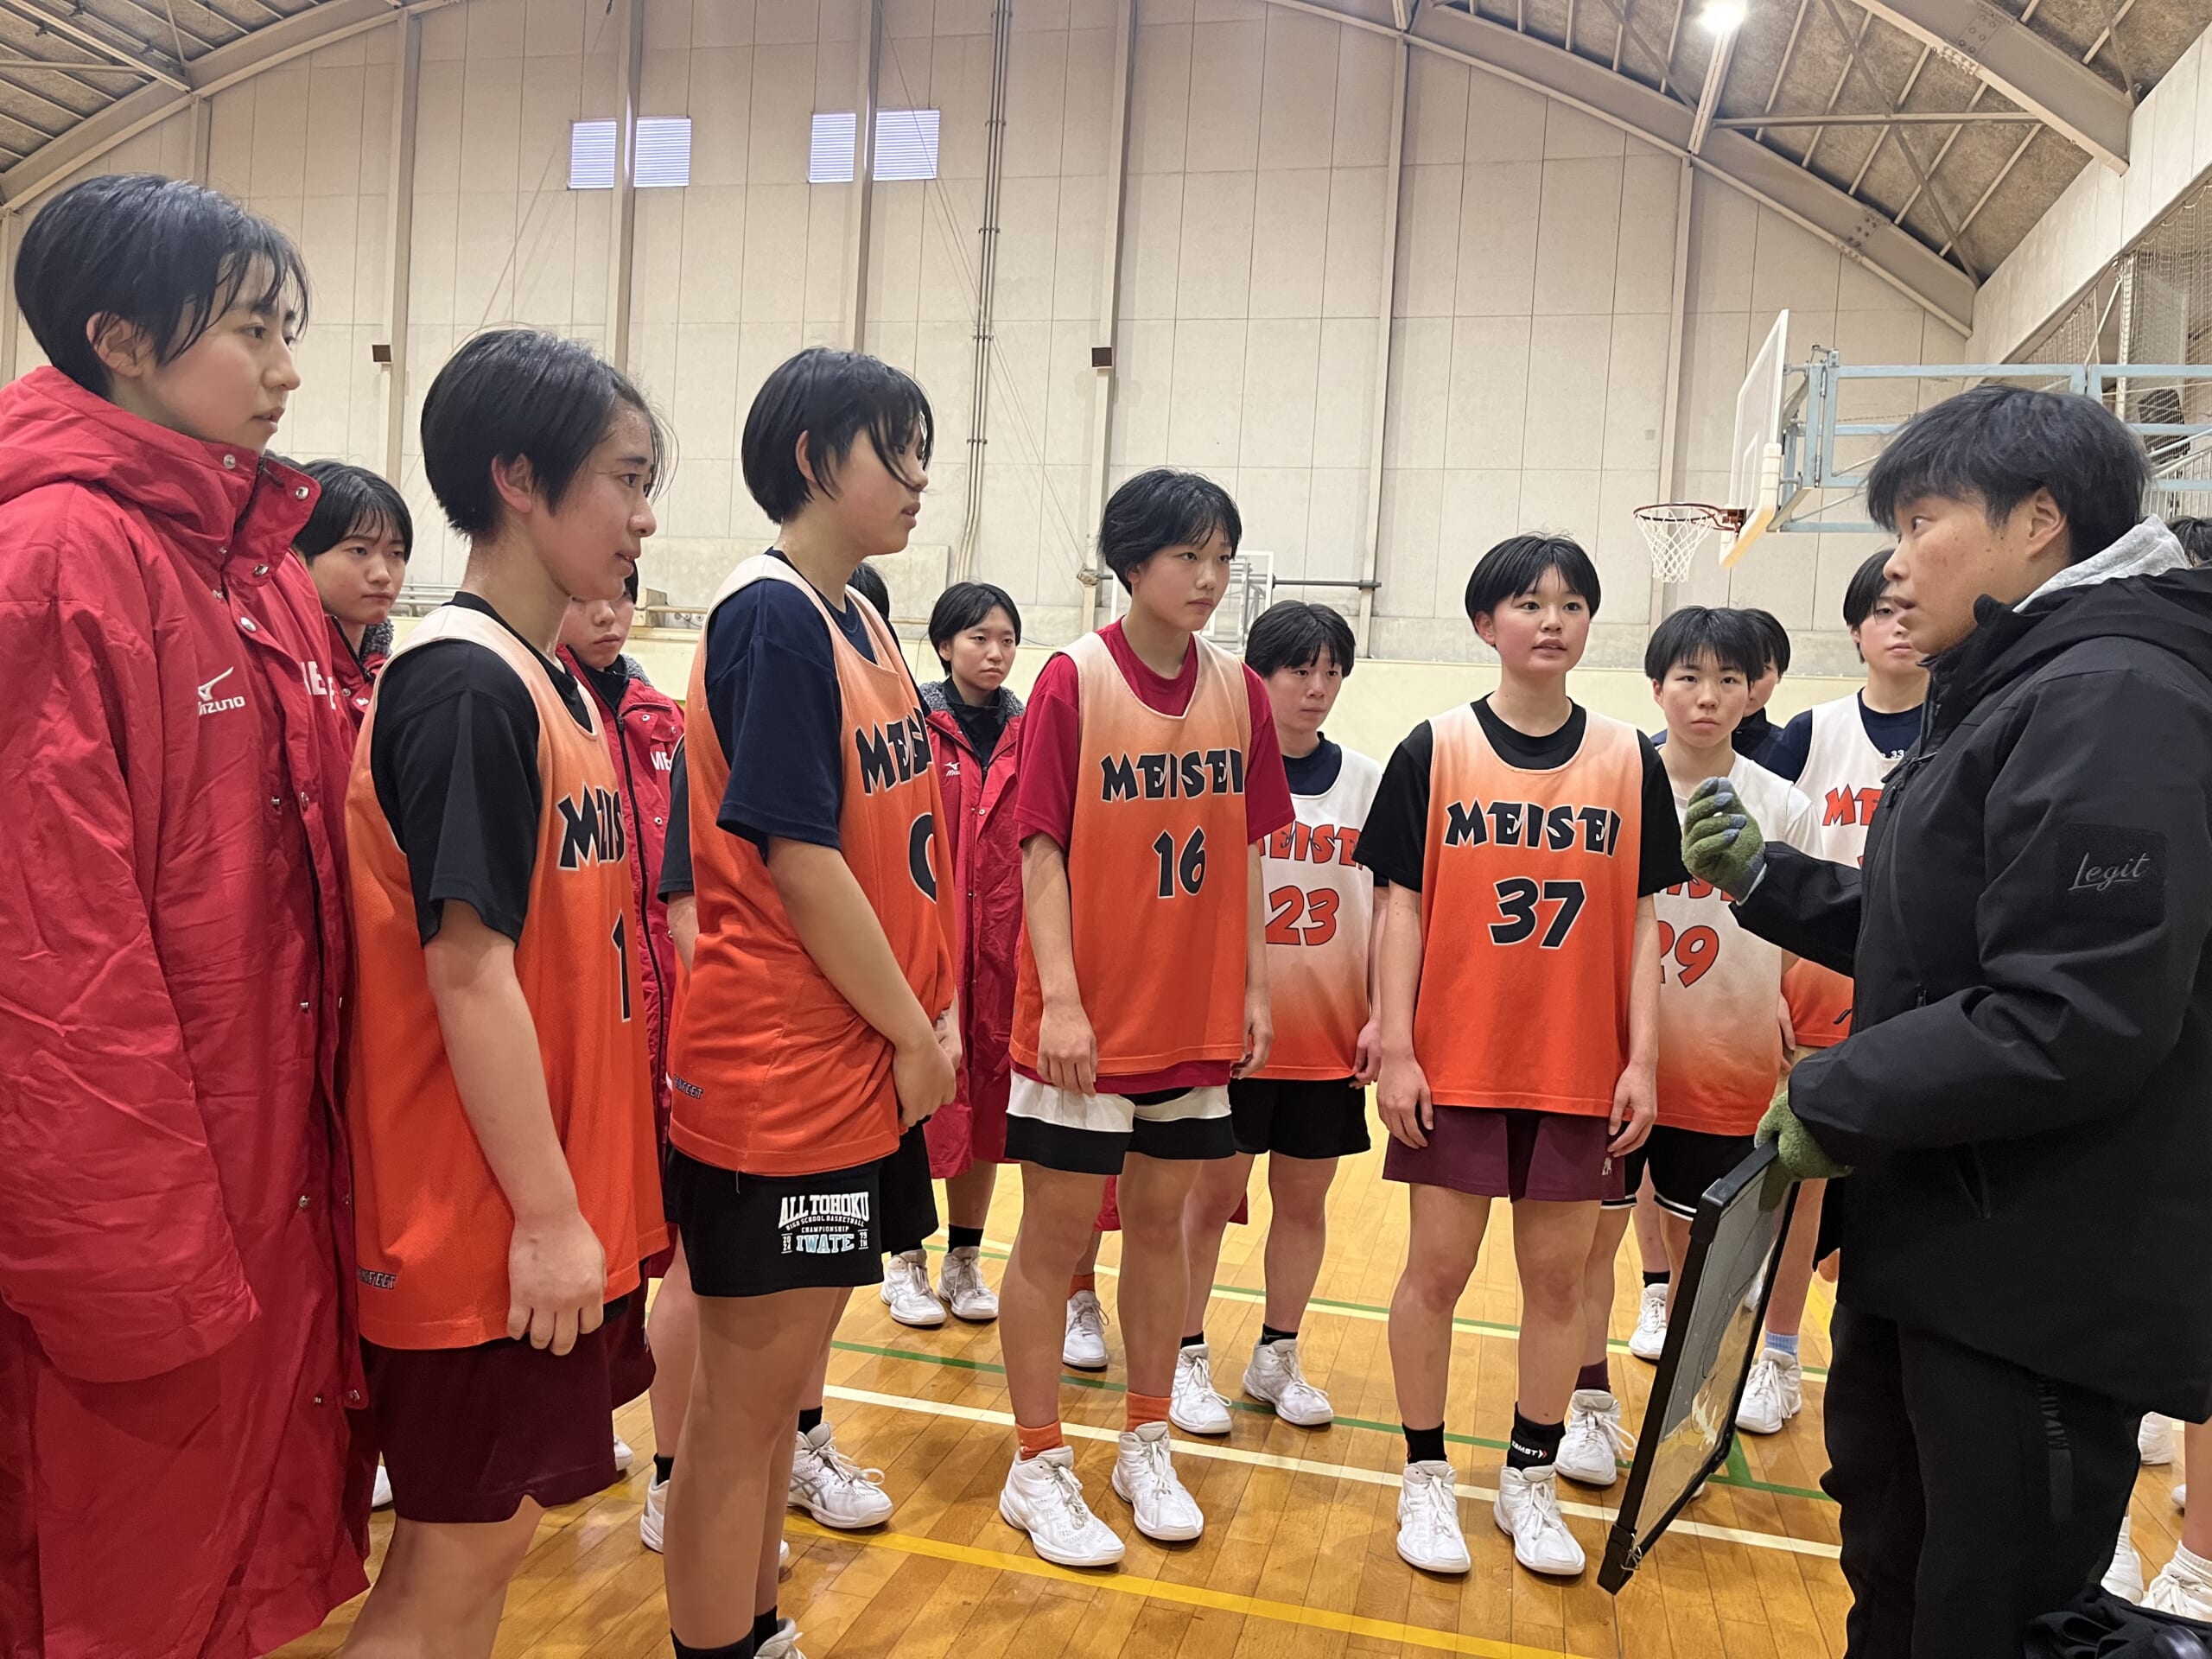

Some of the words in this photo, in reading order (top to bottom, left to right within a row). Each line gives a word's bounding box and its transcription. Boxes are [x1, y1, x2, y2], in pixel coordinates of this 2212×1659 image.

[1100, 748, 1244, 804] MEISEI
[1257, 821, 1363, 871] EISE
[1443, 796, 1622, 857] MEISEI
[1152, 825, 1206, 899] 16
[2067, 851, 2151, 892] Legit
[1265, 885, 1340, 946] 23
[1488, 876, 1586, 950] 37
[778, 1195, 810, 1229] ALL
[810, 1191, 869, 1222] TOHOKU
[785, 1221, 801, 1231] HIGH
[800, 1215, 826, 1225] SCHOOL
[826, 1215, 865, 1227] BASKETBALL
[801, 1225, 849, 1234] CHAMPIONSHIP
[796, 1233, 855, 1254] IWATE
